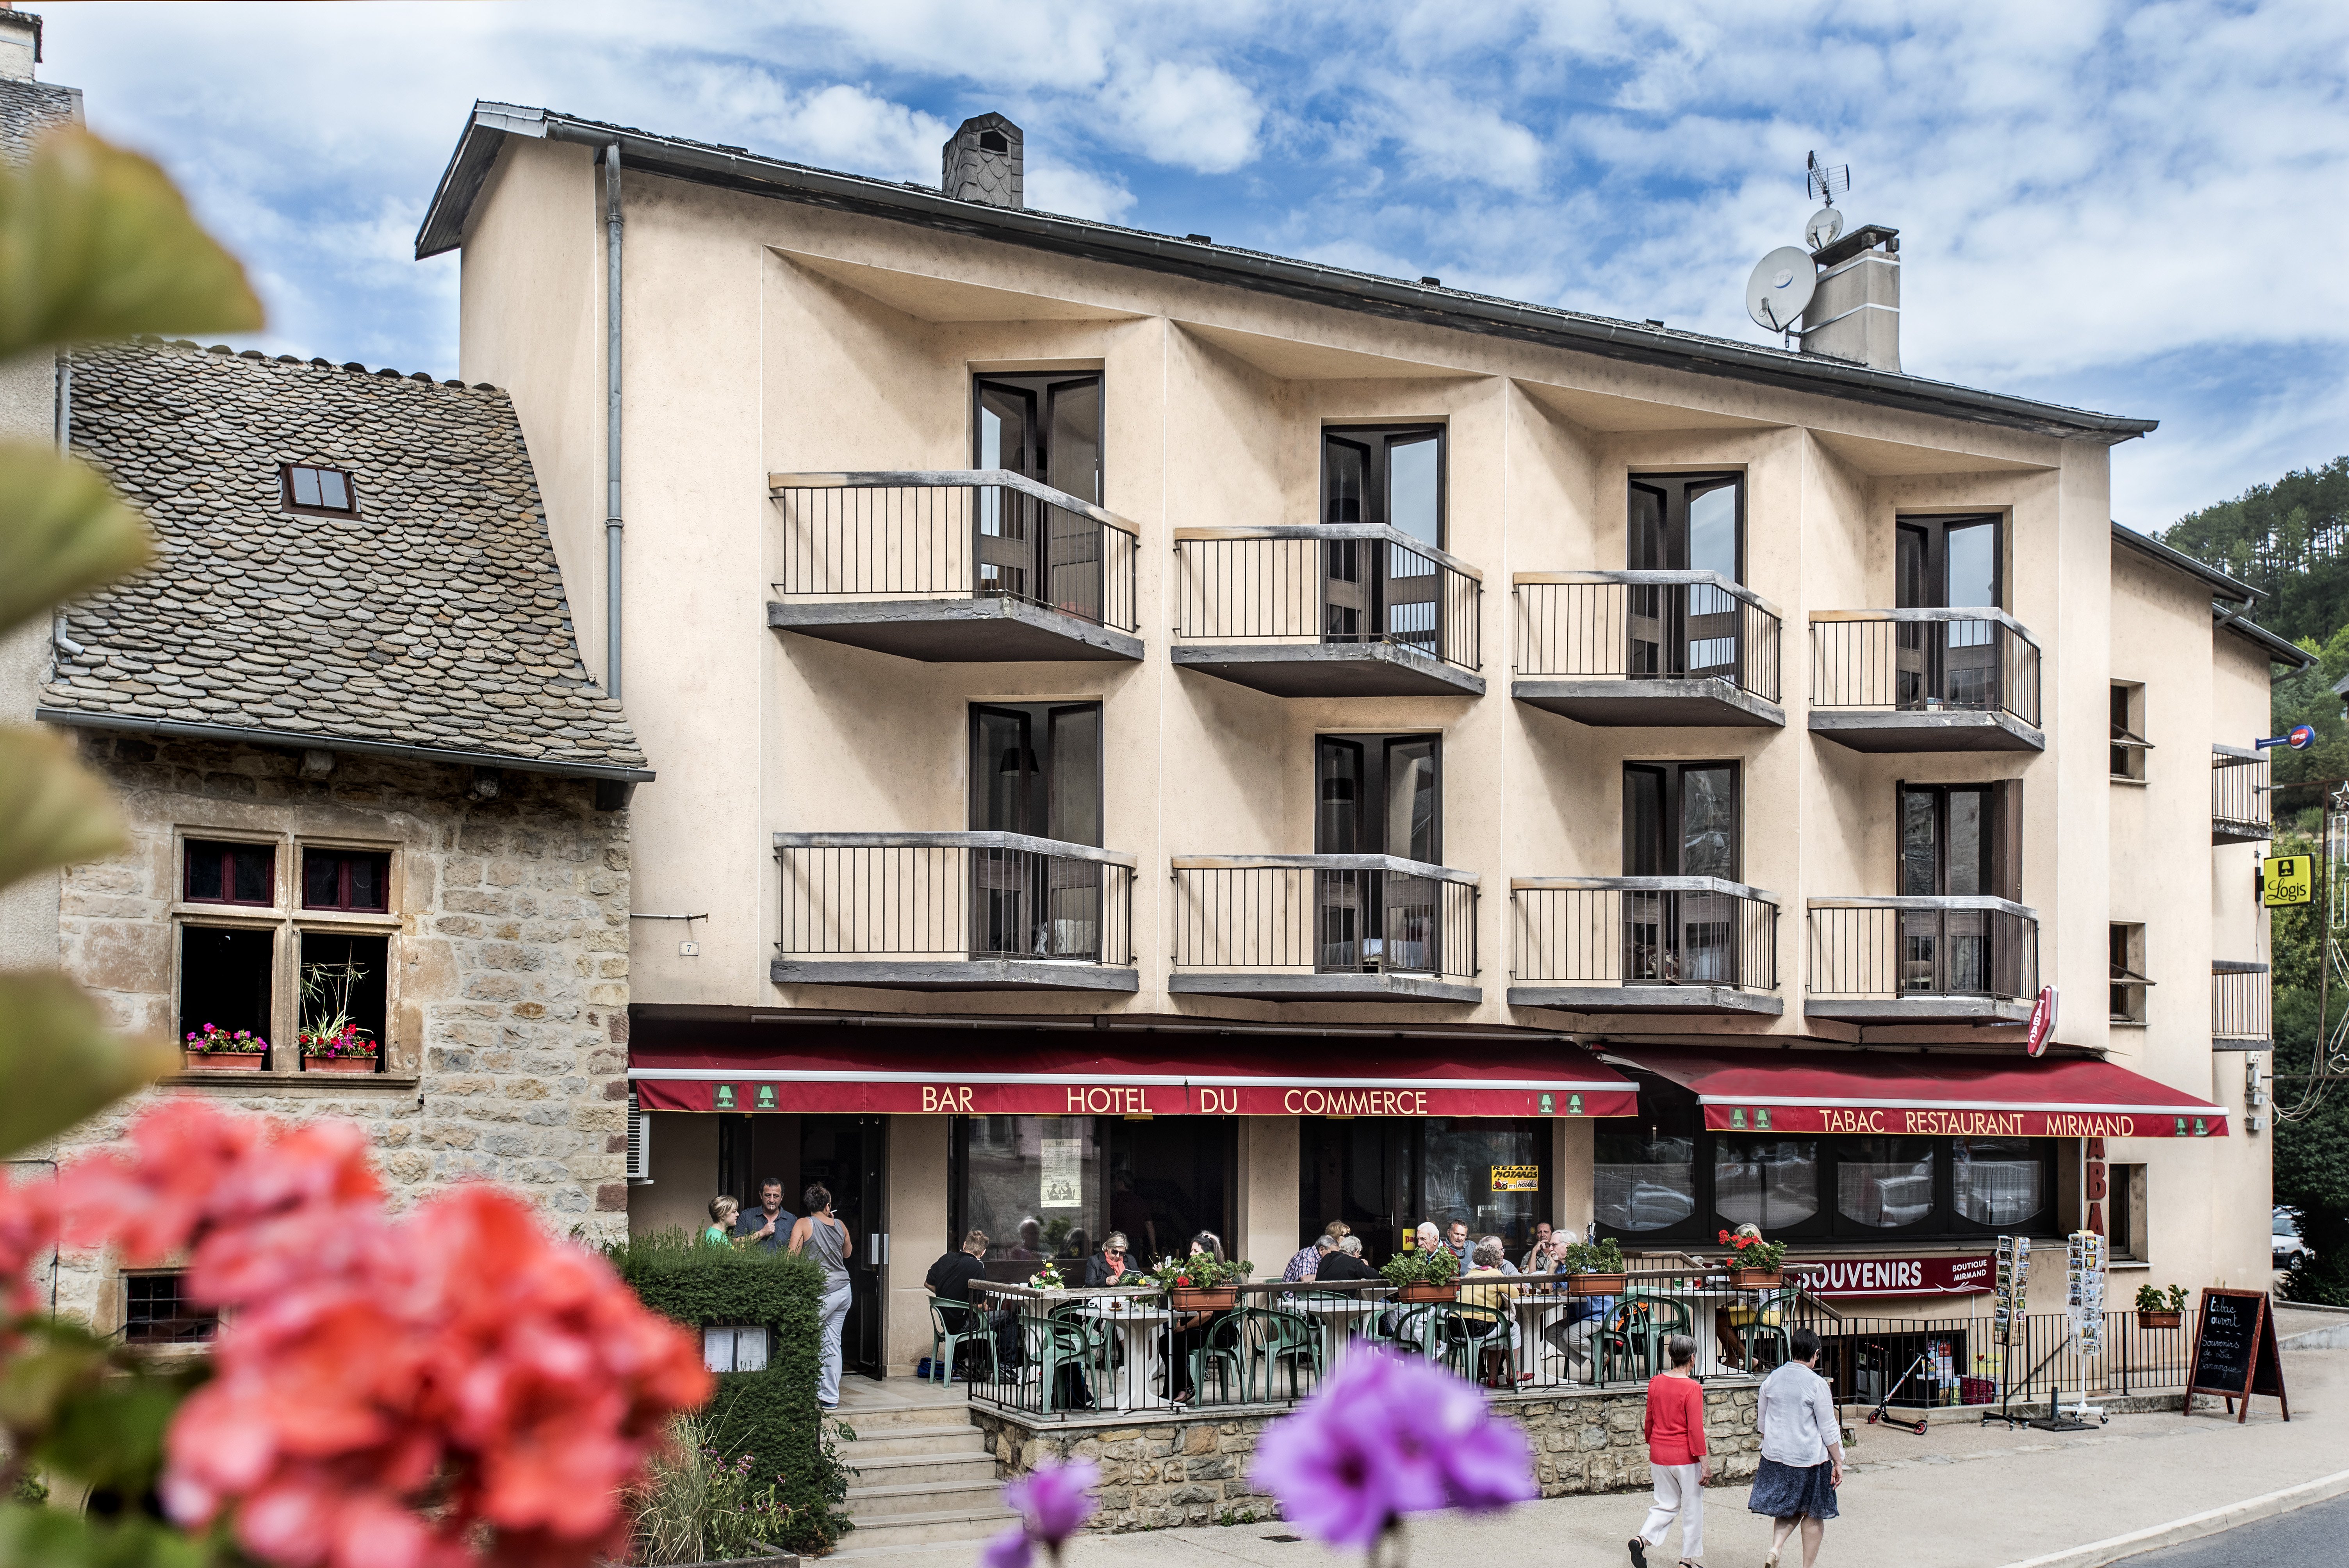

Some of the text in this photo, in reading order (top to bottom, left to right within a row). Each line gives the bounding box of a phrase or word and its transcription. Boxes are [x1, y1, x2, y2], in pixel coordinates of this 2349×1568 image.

[2266, 878, 2306, 901] Logis
[2029, 999, 2045, 1043] TABAC
[923, 1086, 1428, 1114] BAR HOTEL DU COMMERCE
[1819, 1110, 2134, 1136] TABAC RESTAURANT MIRMAND
[1952, 1259, 1987, 1272] BOUTIQUE
[1954, 1269, 1986, 1281] MIRMAND
[2210, 1296, 2237, 1313] tabac
[715, 1317, 762, 1326] MEN
[2211, 1314, 2241, 1327] ouvert
[2202, 1335, 2240, 1349] Souvenirs
